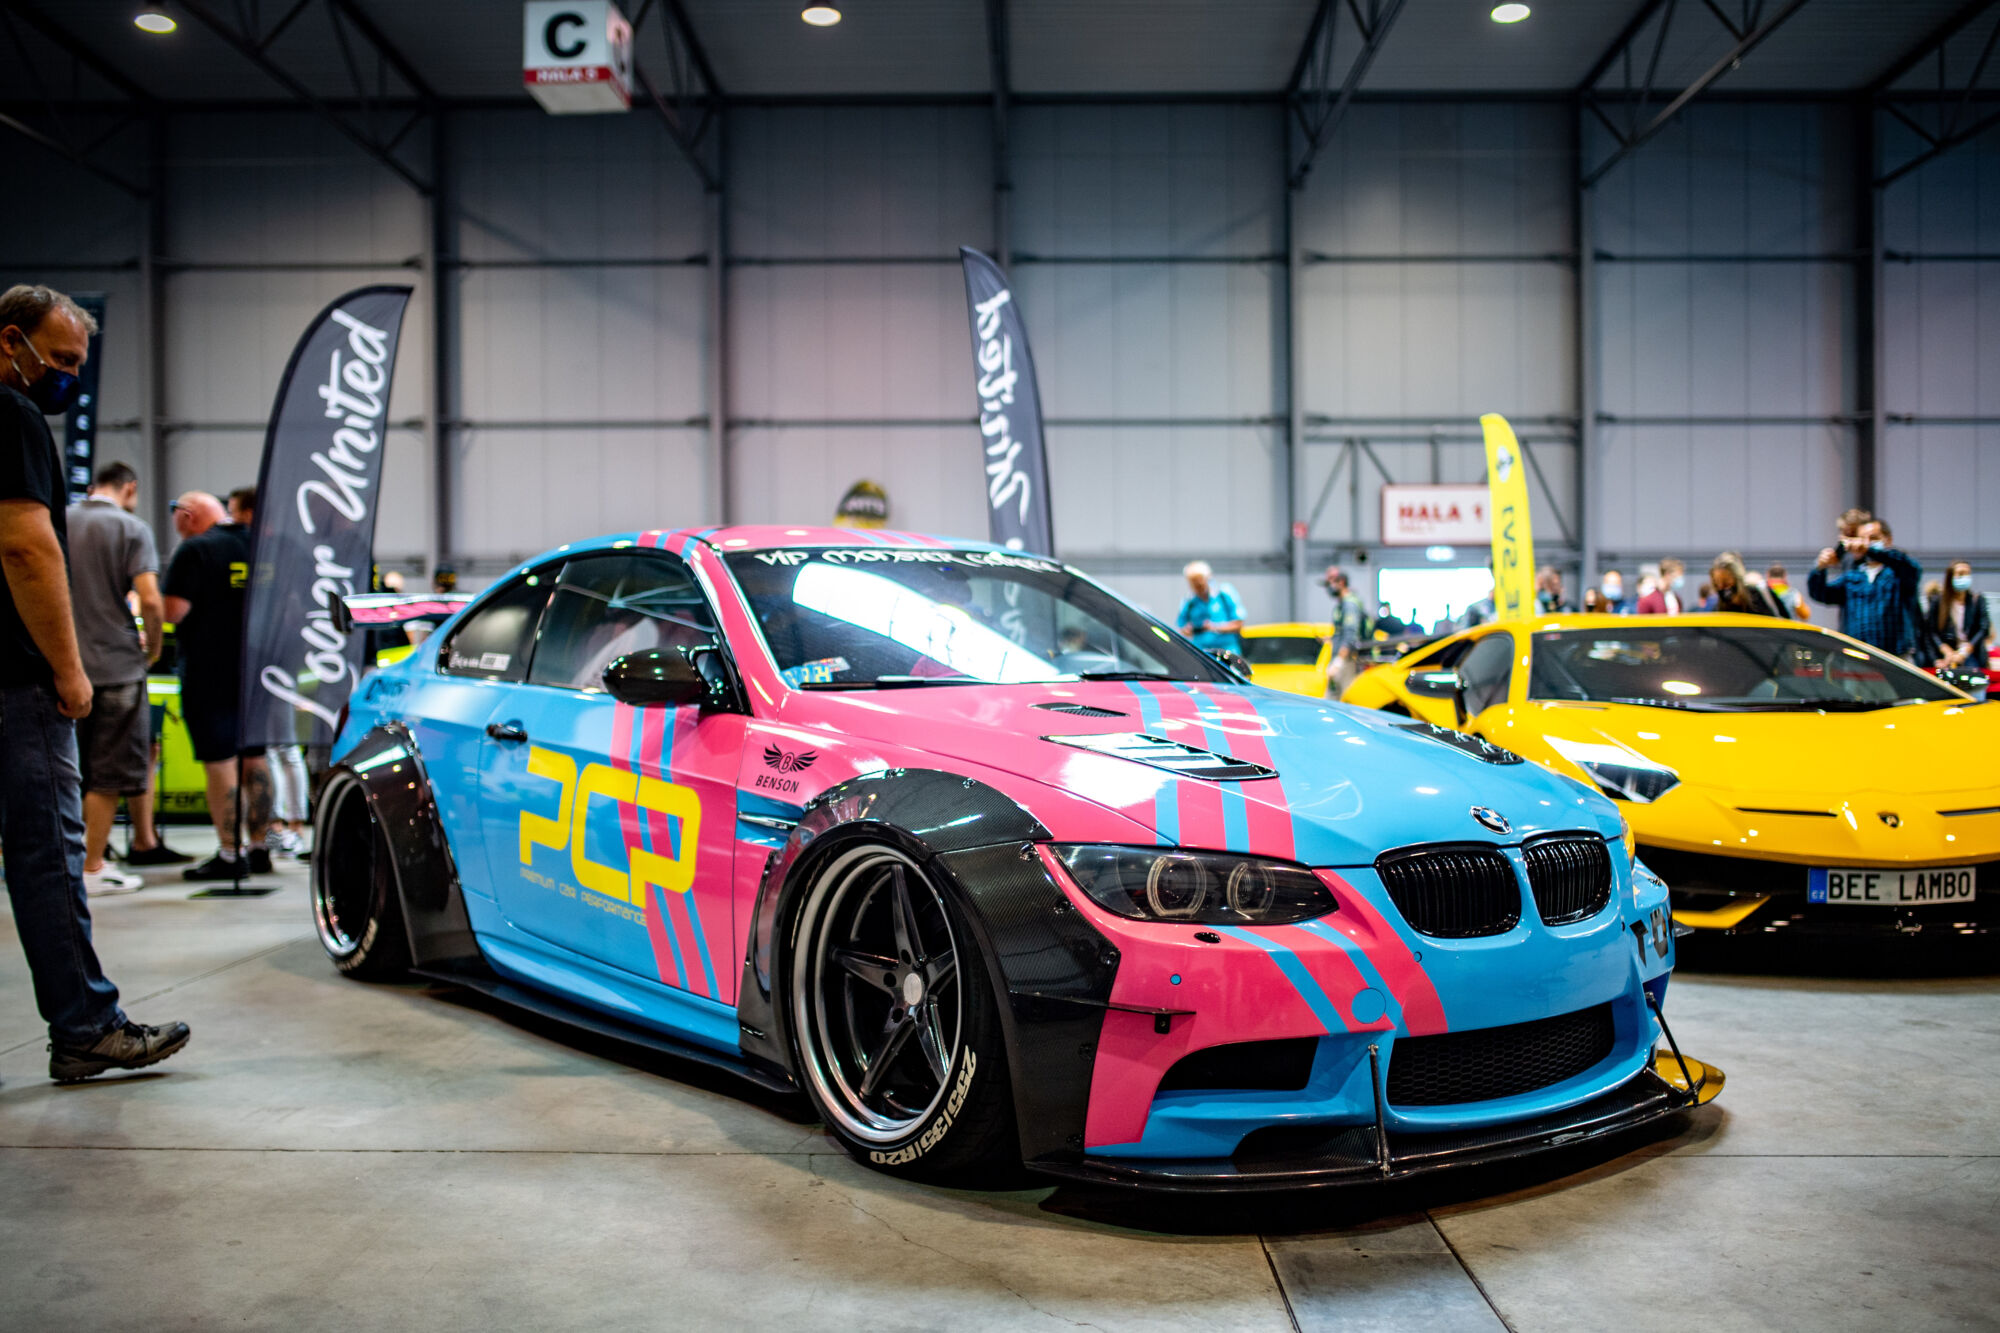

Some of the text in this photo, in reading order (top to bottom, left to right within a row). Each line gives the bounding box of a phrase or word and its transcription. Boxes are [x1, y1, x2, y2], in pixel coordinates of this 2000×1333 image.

[545, 12, 586, 59] C
[296, 308, 389, 534] United
[1398, 502, 1462, 524] HALA
[755, 774, 800, 793] BENSON
[1829, 871, 1972, 901] BEE LAMBO
